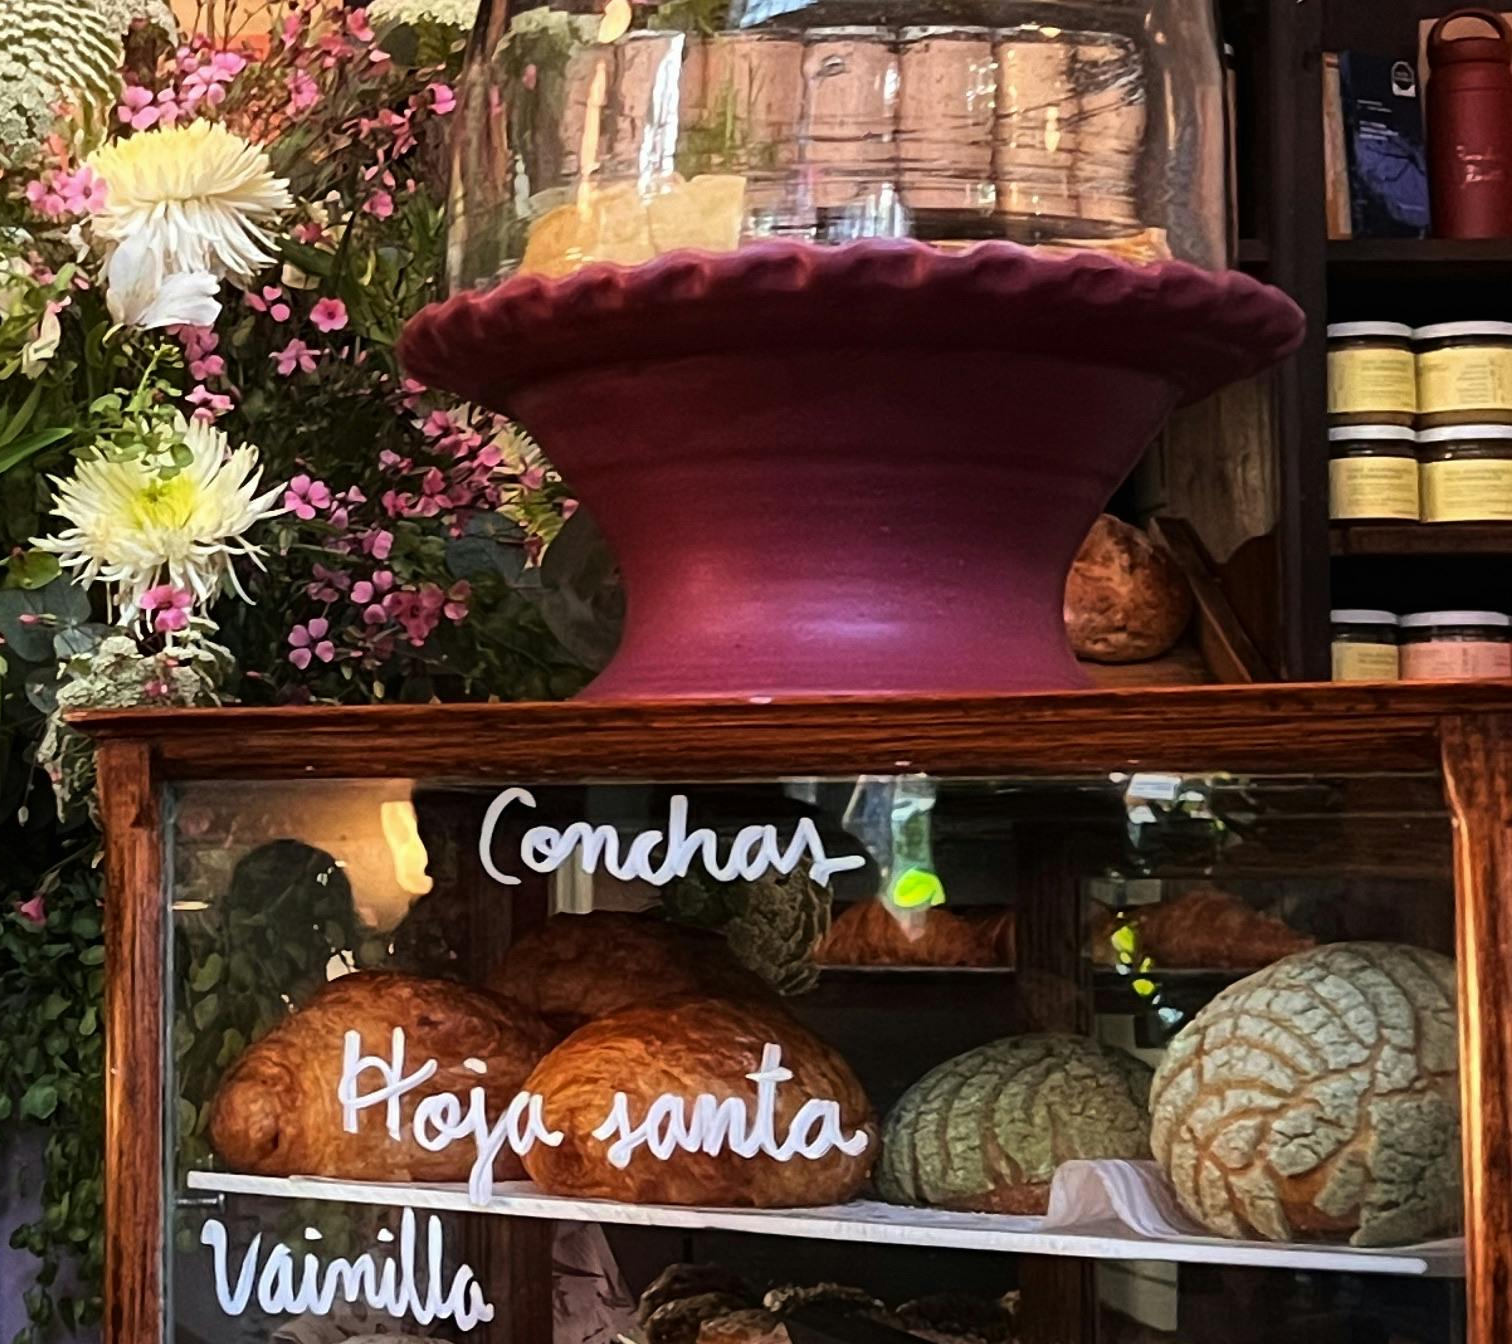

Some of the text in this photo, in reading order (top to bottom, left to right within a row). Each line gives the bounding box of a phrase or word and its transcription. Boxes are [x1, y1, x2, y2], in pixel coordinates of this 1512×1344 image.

[479, 787, 865, 887] Conchas
[337, 1026, 869, 1207] Hoja santa
[201, 1207, 494, 1332] Vainilla
